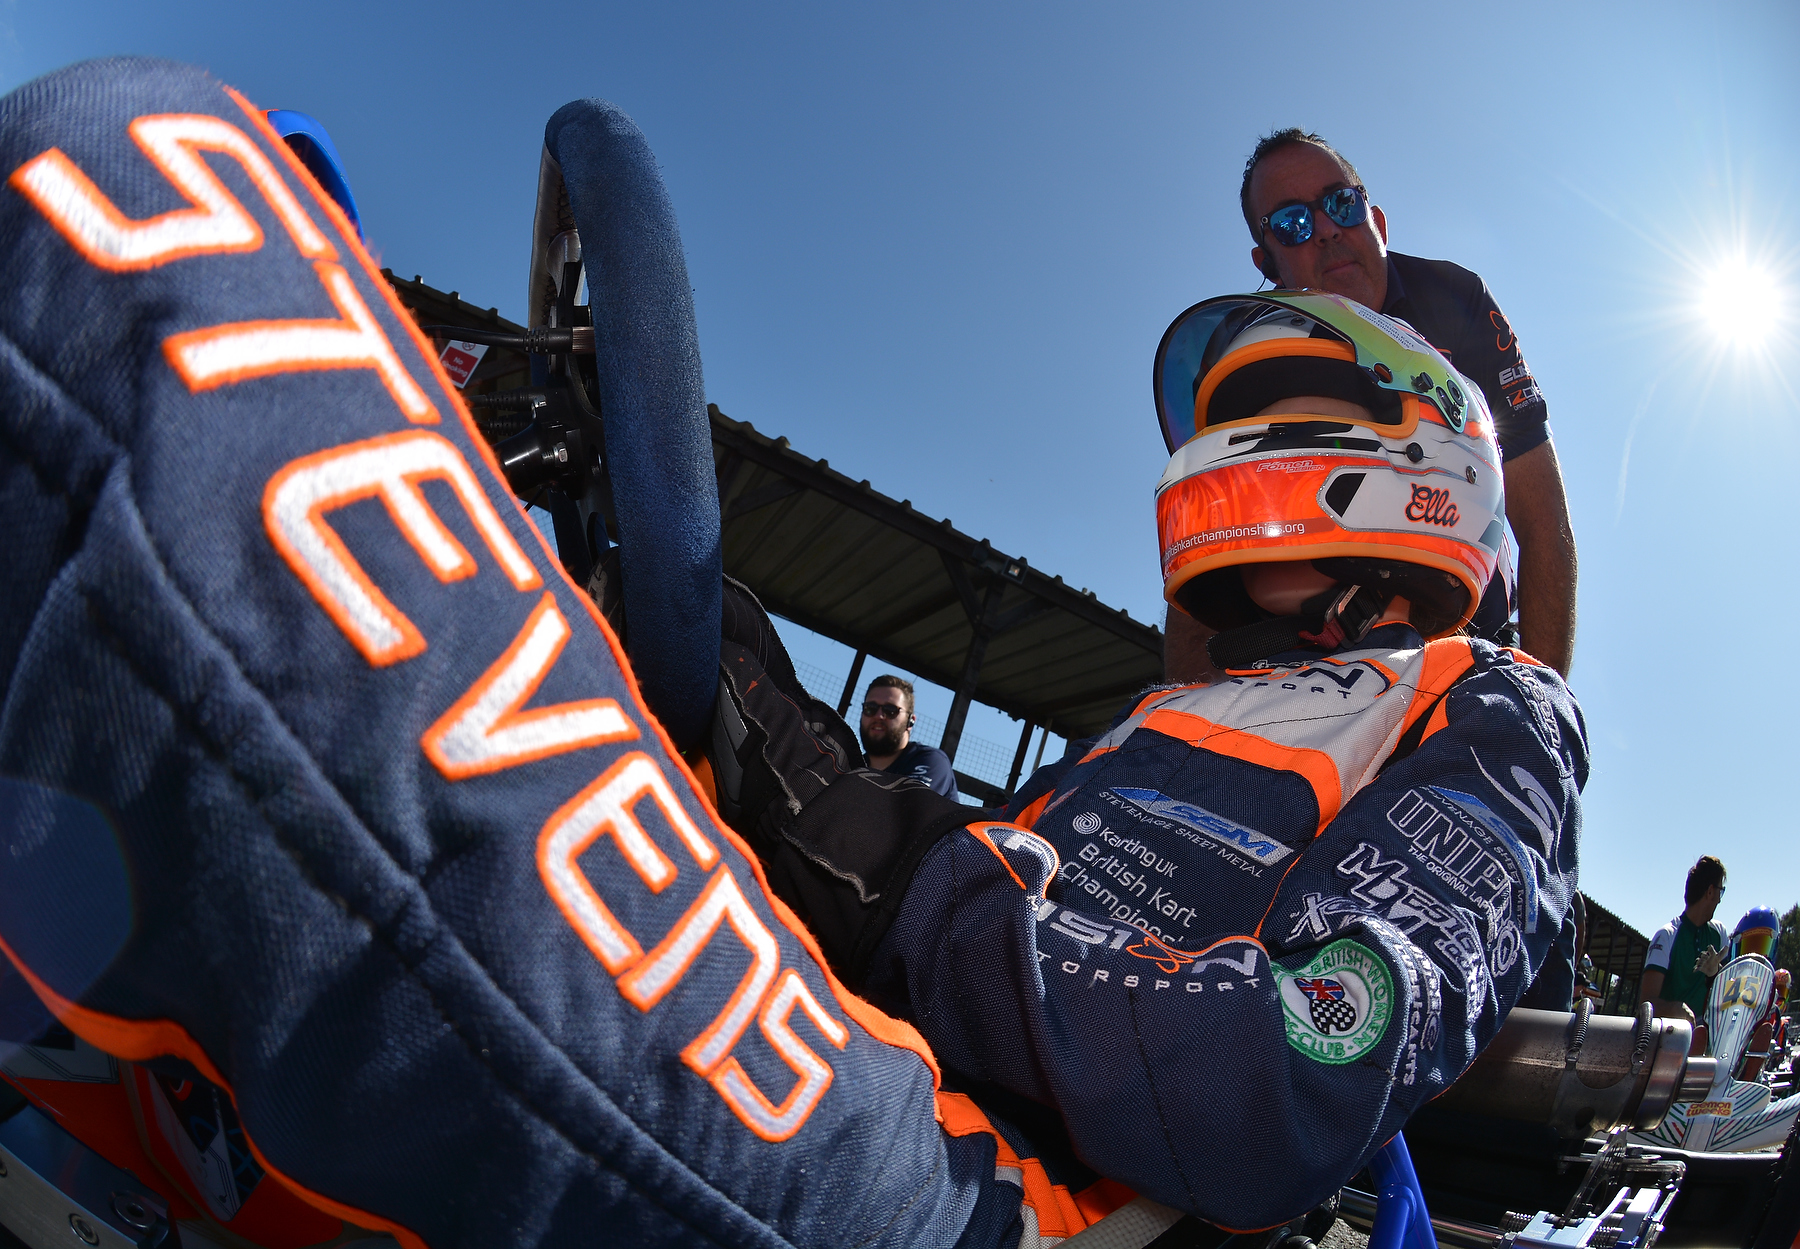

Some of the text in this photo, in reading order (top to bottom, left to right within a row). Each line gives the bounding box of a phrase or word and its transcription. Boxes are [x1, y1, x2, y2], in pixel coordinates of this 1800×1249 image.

[441, 360, 468, 377] Smoking
[453, 357, 464, 365] No
[1405, 483, 1461, 528] Ella
[1098, 790, 1264, 878] STEVENAGE SHEET METAL
[1098, 827, 1180, 879] Karting UK
[1078, 842, 1198, 929] British Kart
[1408, 845, 1428, 863] THE
[1425, 861, 1468, 897] ORIGINAL
[1311, 948, 1388, 1048] BRITISH WOMEN
[1721, 976, 1759, 1006] 45
[1297, 1031, 1346, 1058] CLUB
